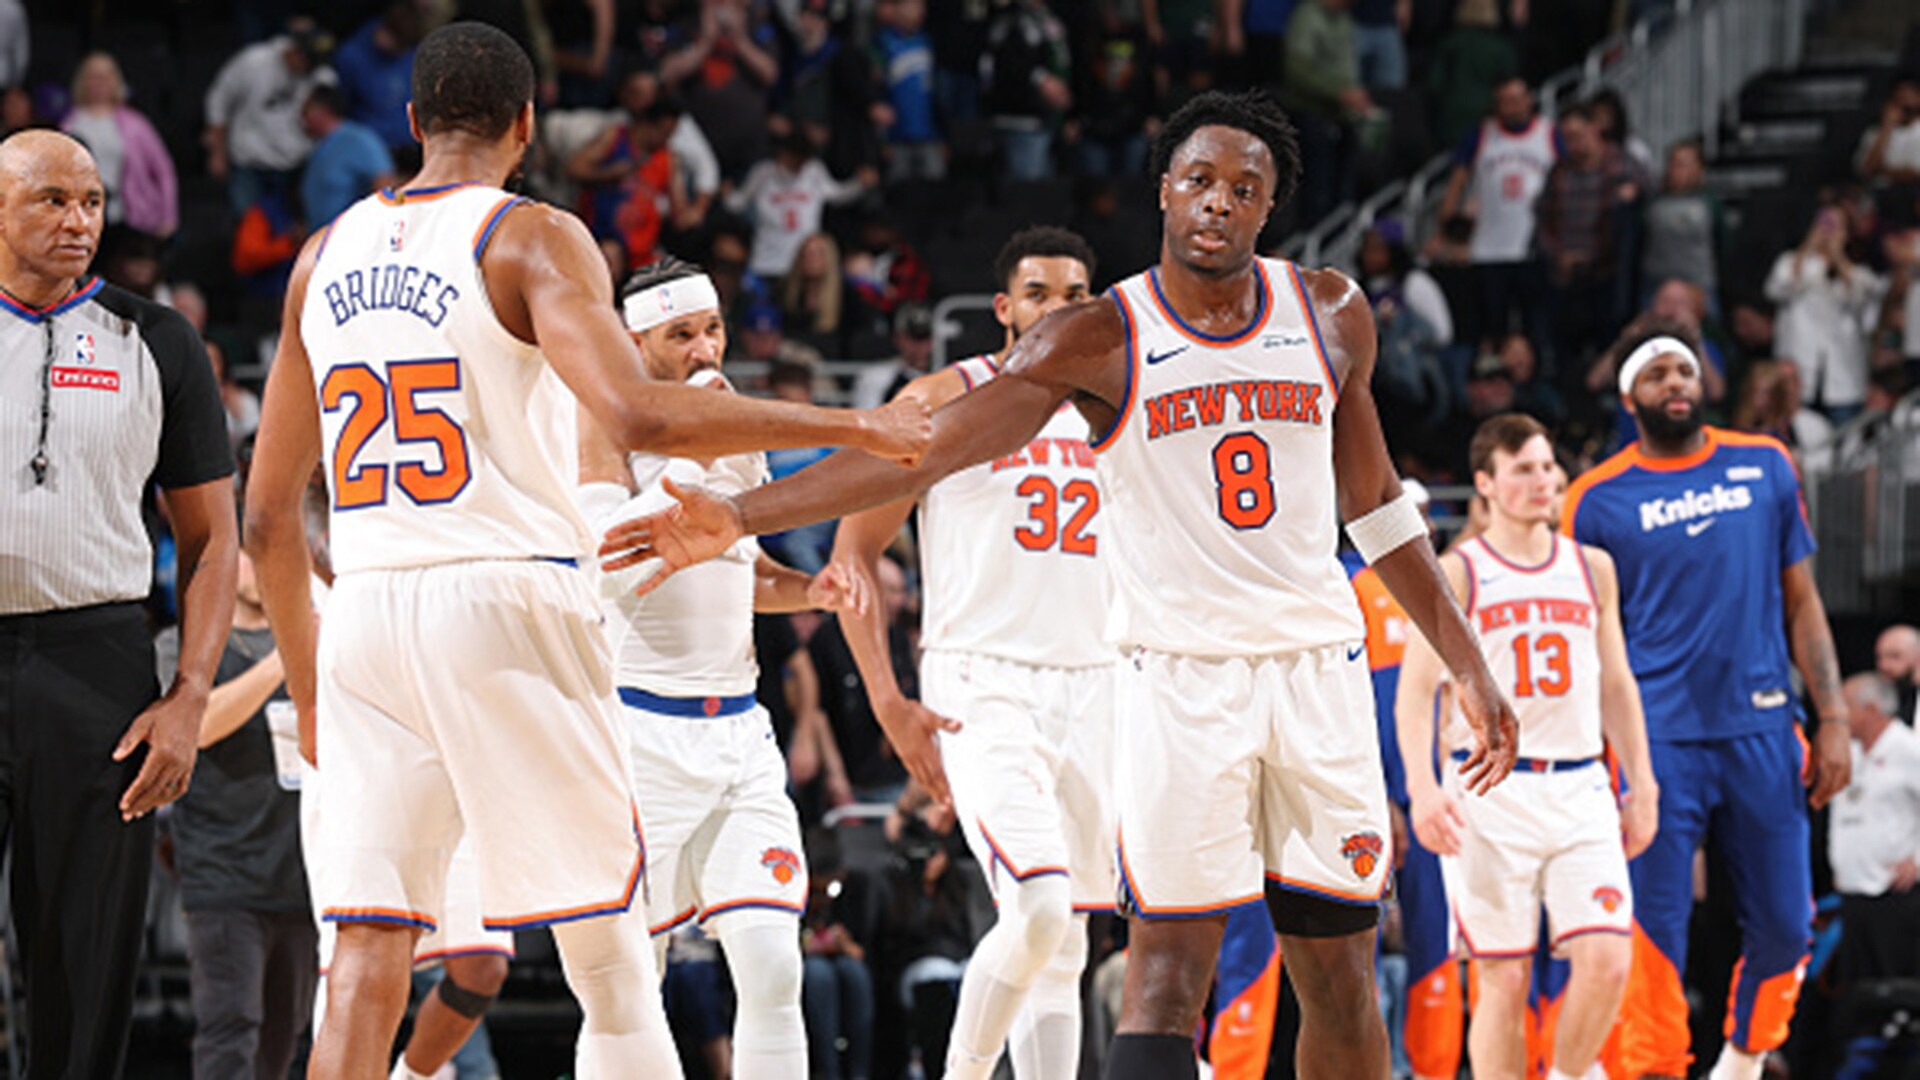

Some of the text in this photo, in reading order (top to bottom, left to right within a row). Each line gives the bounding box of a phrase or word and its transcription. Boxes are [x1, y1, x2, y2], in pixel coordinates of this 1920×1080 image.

[324, 263, 459, 328] BRIDGES
[320, 357, 472, 512] 25
[1145, 379, 1323, 441] NEW YORK
[1212, 431, 1277, 531] 8
[1640, 484, 1753, 531] Knicks
[1014, 474, 1100, 557] 32
[1478, 599, 1530, 635] NEW
[1512, 631, 1573, 699] 13
